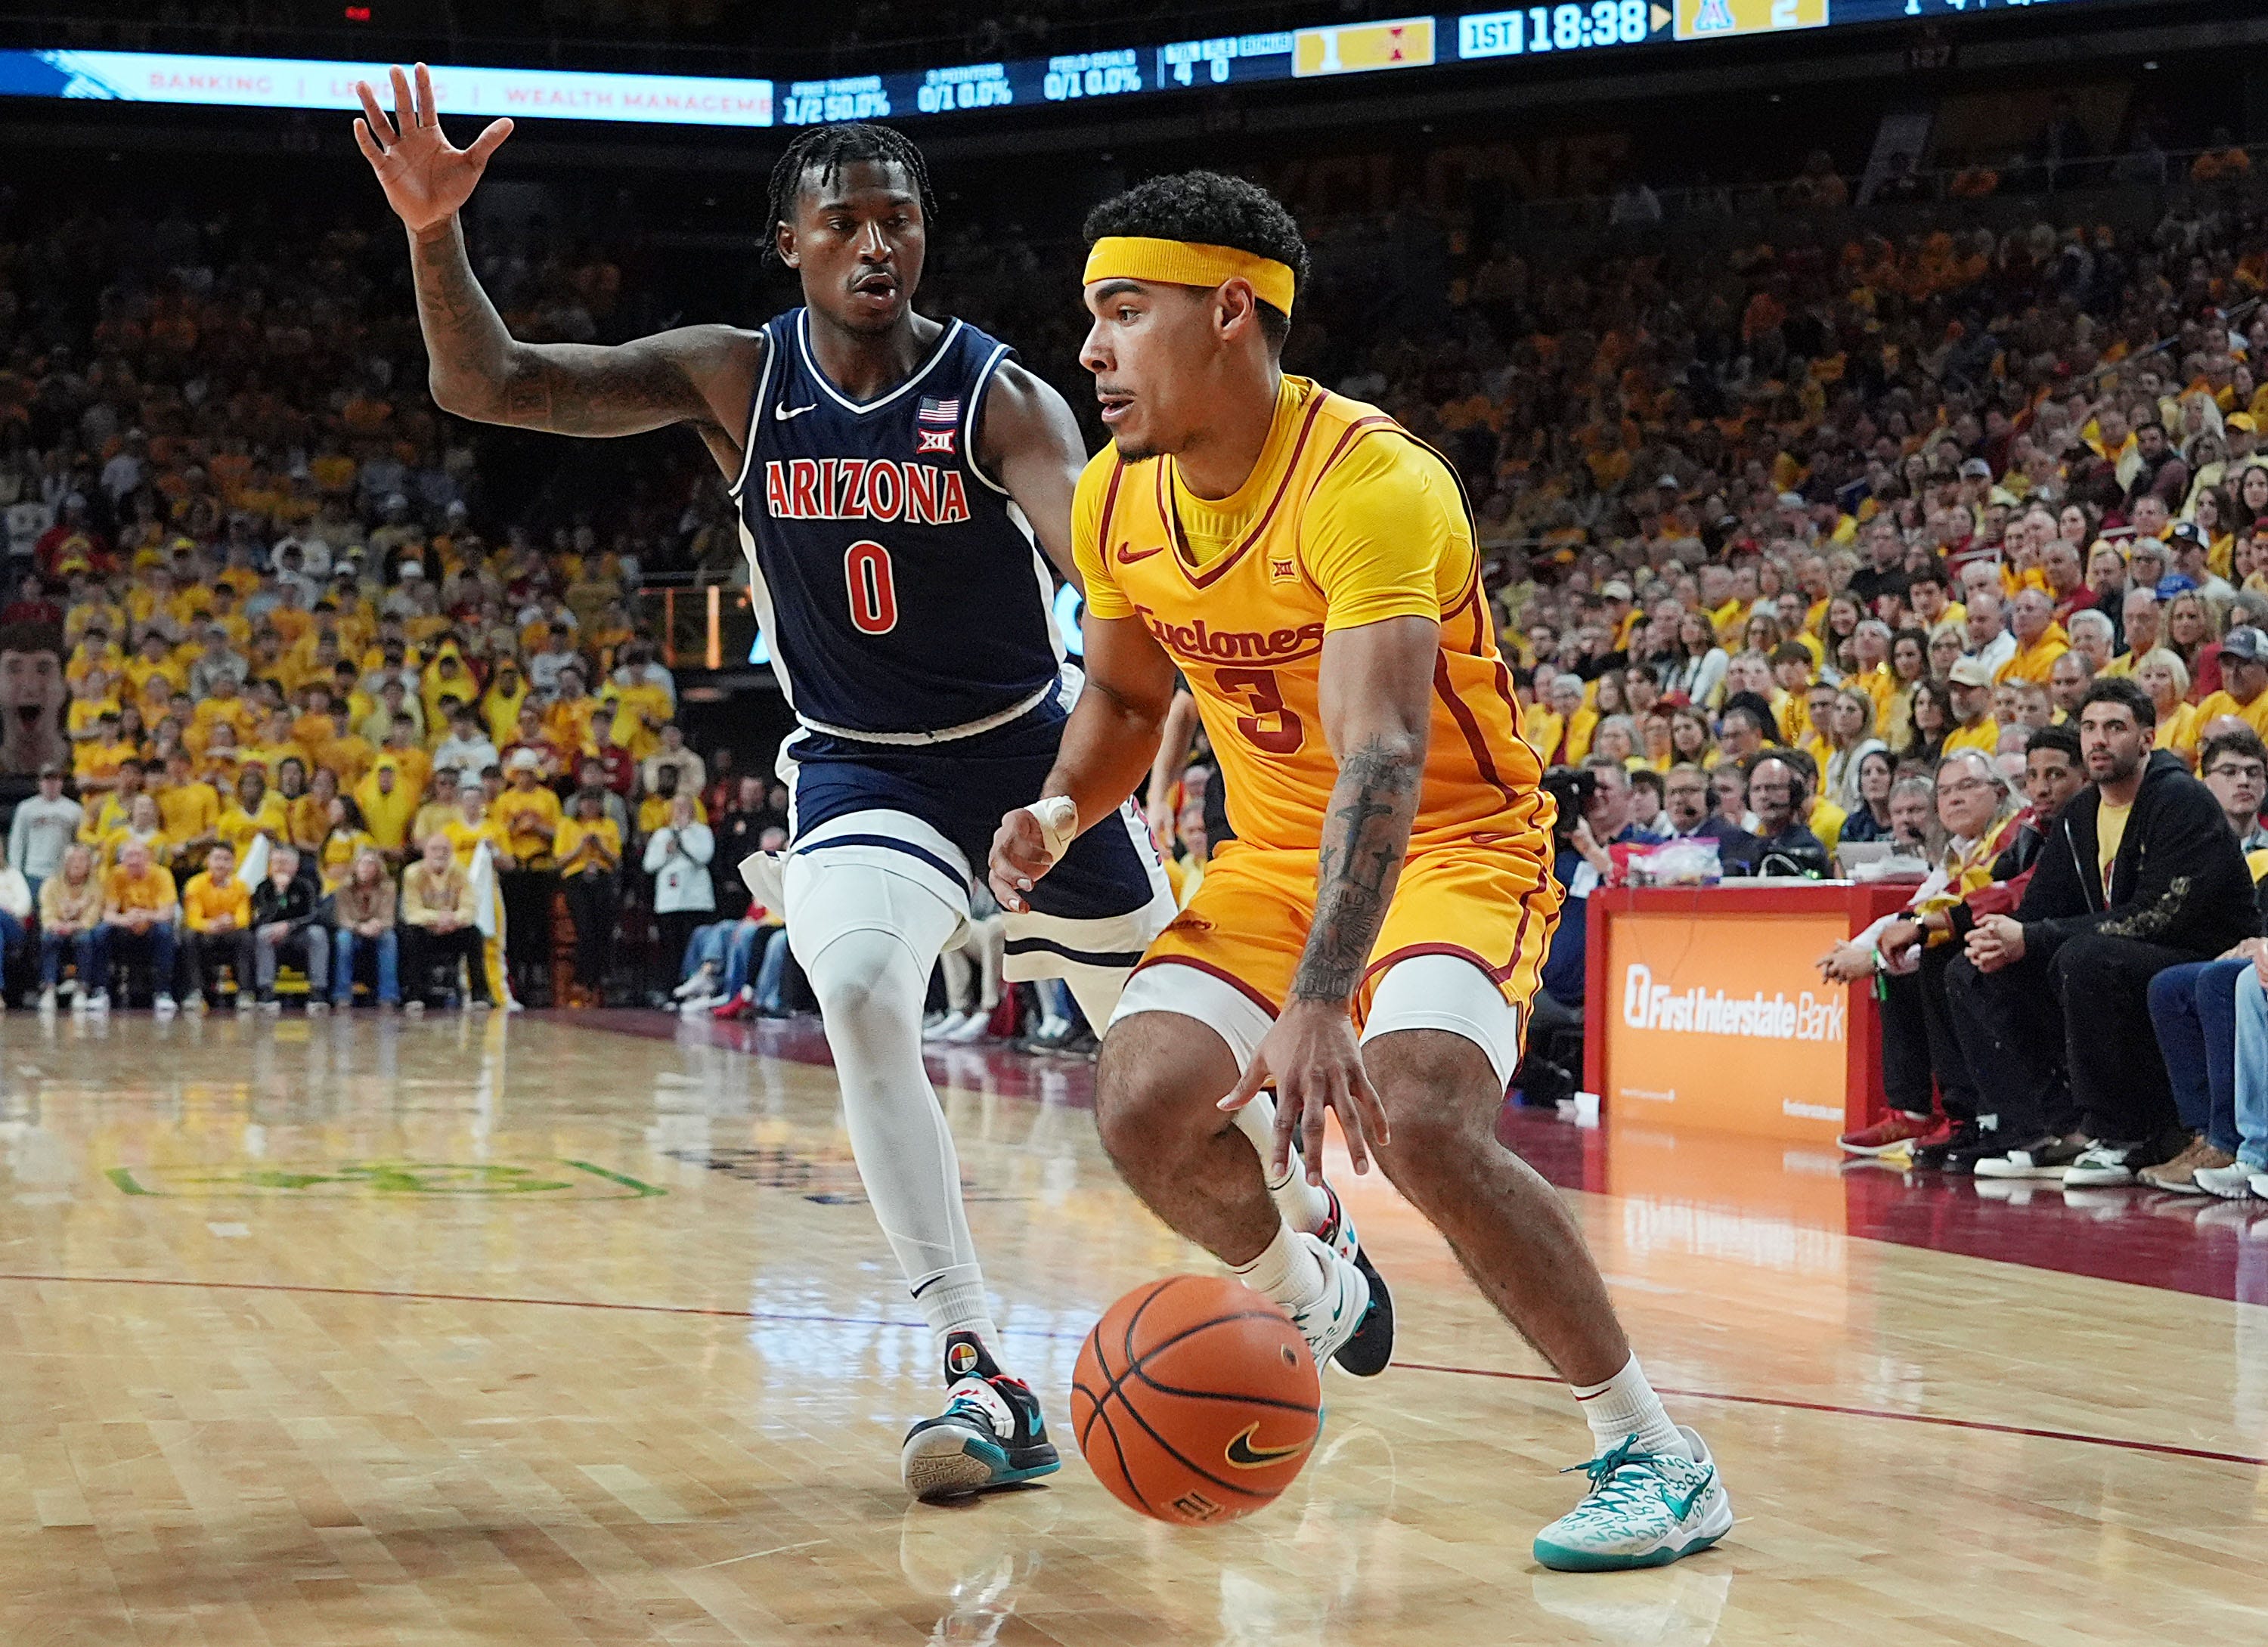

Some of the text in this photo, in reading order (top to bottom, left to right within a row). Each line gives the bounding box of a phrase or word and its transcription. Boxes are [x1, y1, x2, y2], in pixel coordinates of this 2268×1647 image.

[1469, 20, 1513, 51] 1ST
[1528, 0, 1647, 51] 18:38
[1210, 57, 1230, 83] 0
[1319, 29, 1343, 72] 1
[149, 72, 274, 95] BANKING
[504, 85, 614, 108] WEALTH
[765, 458, 971, 525] ARIZONA
[844, 539, 898, 635] 0
[1213, 667, 1307, 756] 3
[1648, 983, 1845, 1042] First Interstate Bank
